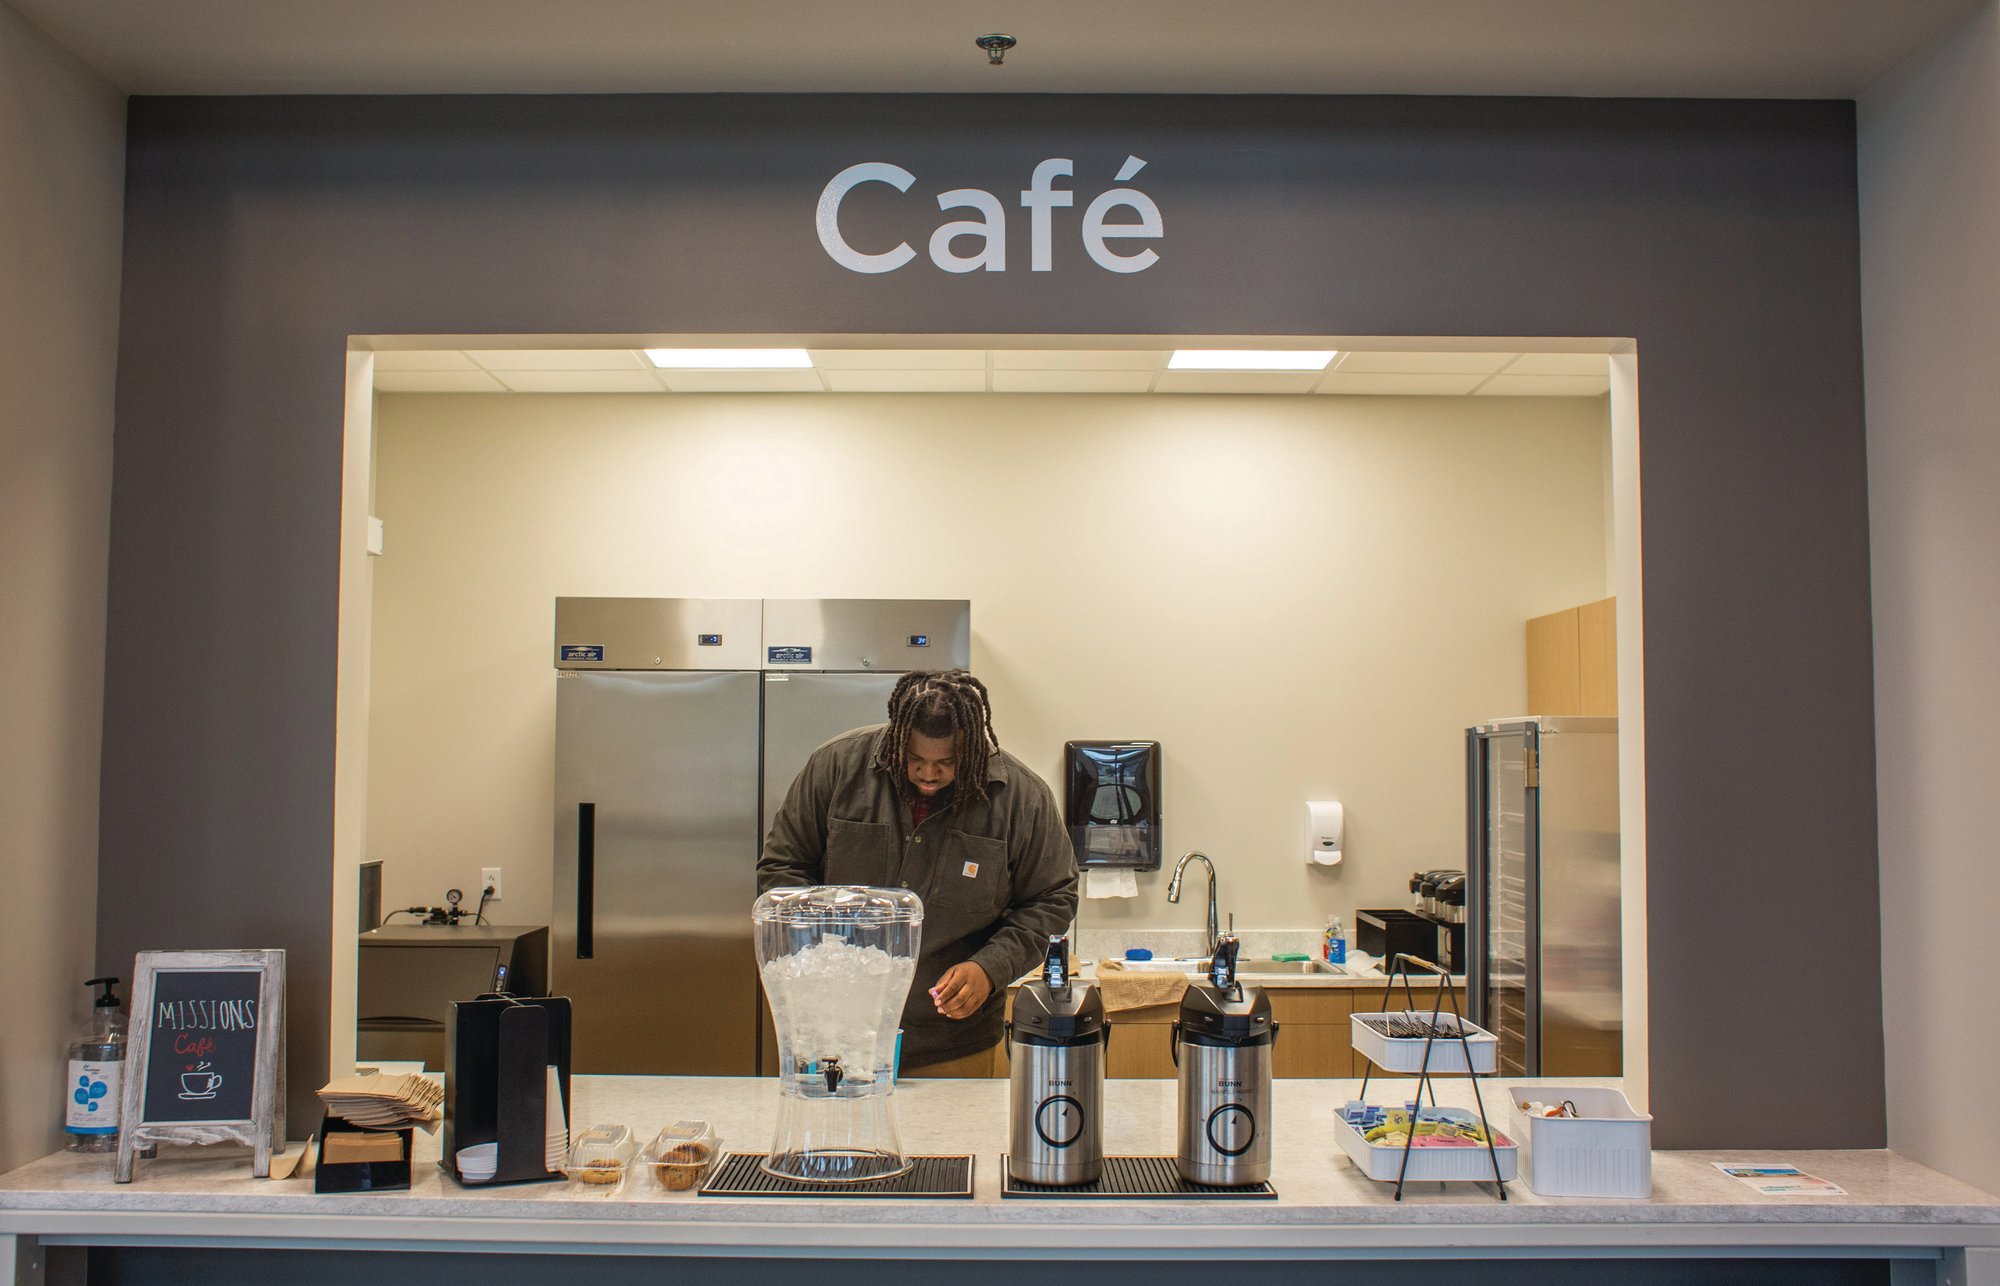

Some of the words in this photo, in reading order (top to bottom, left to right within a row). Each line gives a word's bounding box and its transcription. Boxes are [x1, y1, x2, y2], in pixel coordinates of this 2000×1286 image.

[815, 154, 1164, 274] Café
[158, 1000, 255, 1031] MISSIONS
[174, 1033, 216, 1057] Café
[1218, 1080, 1242, 1088] BUNN
